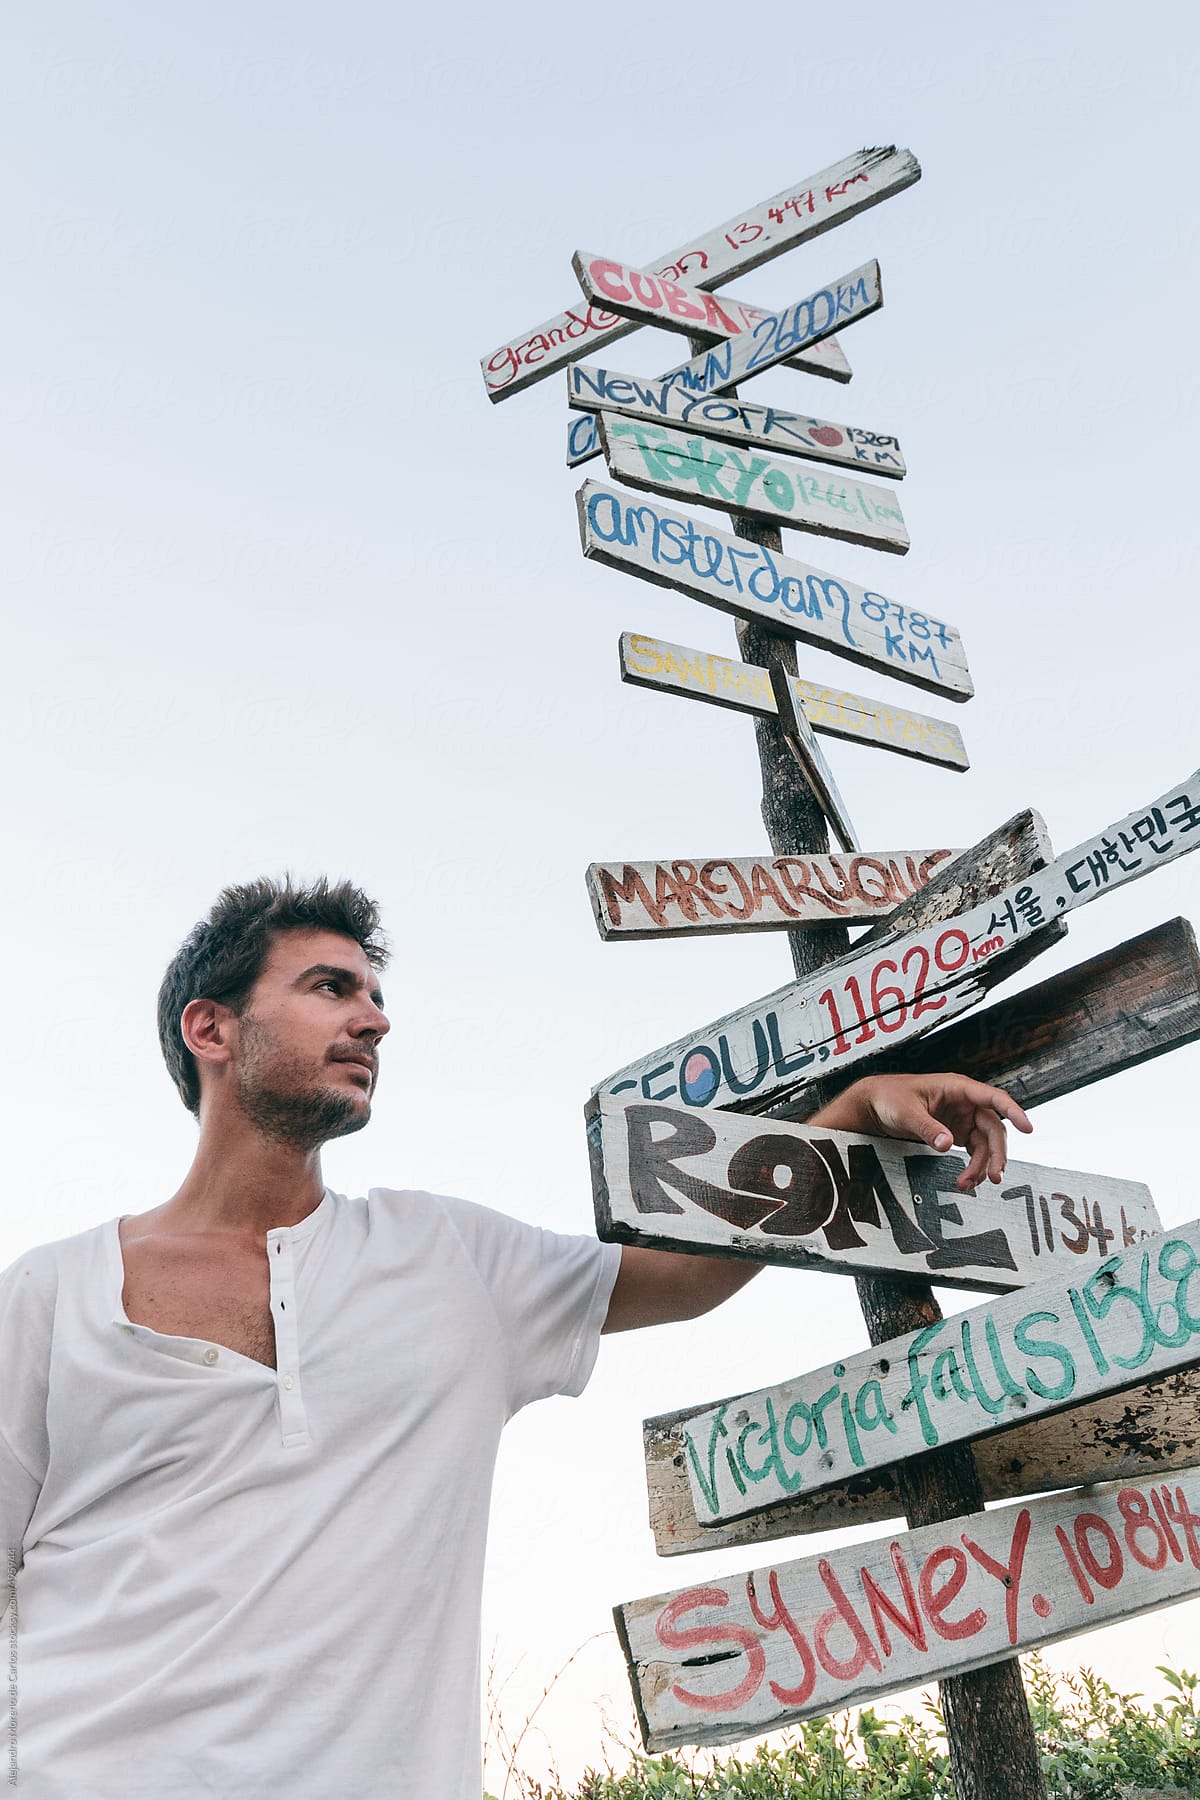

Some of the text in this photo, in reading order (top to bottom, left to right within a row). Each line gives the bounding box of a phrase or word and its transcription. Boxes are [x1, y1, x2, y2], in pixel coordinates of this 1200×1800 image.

[588, 259, 743, 336] CUBA
[860, 591, 954, 651] 8787
[818, 928, 970, 1056] 11620
[623, 1104, 1019, 1272] ROME
[1000, 1184, 1114, 1257] 7134
